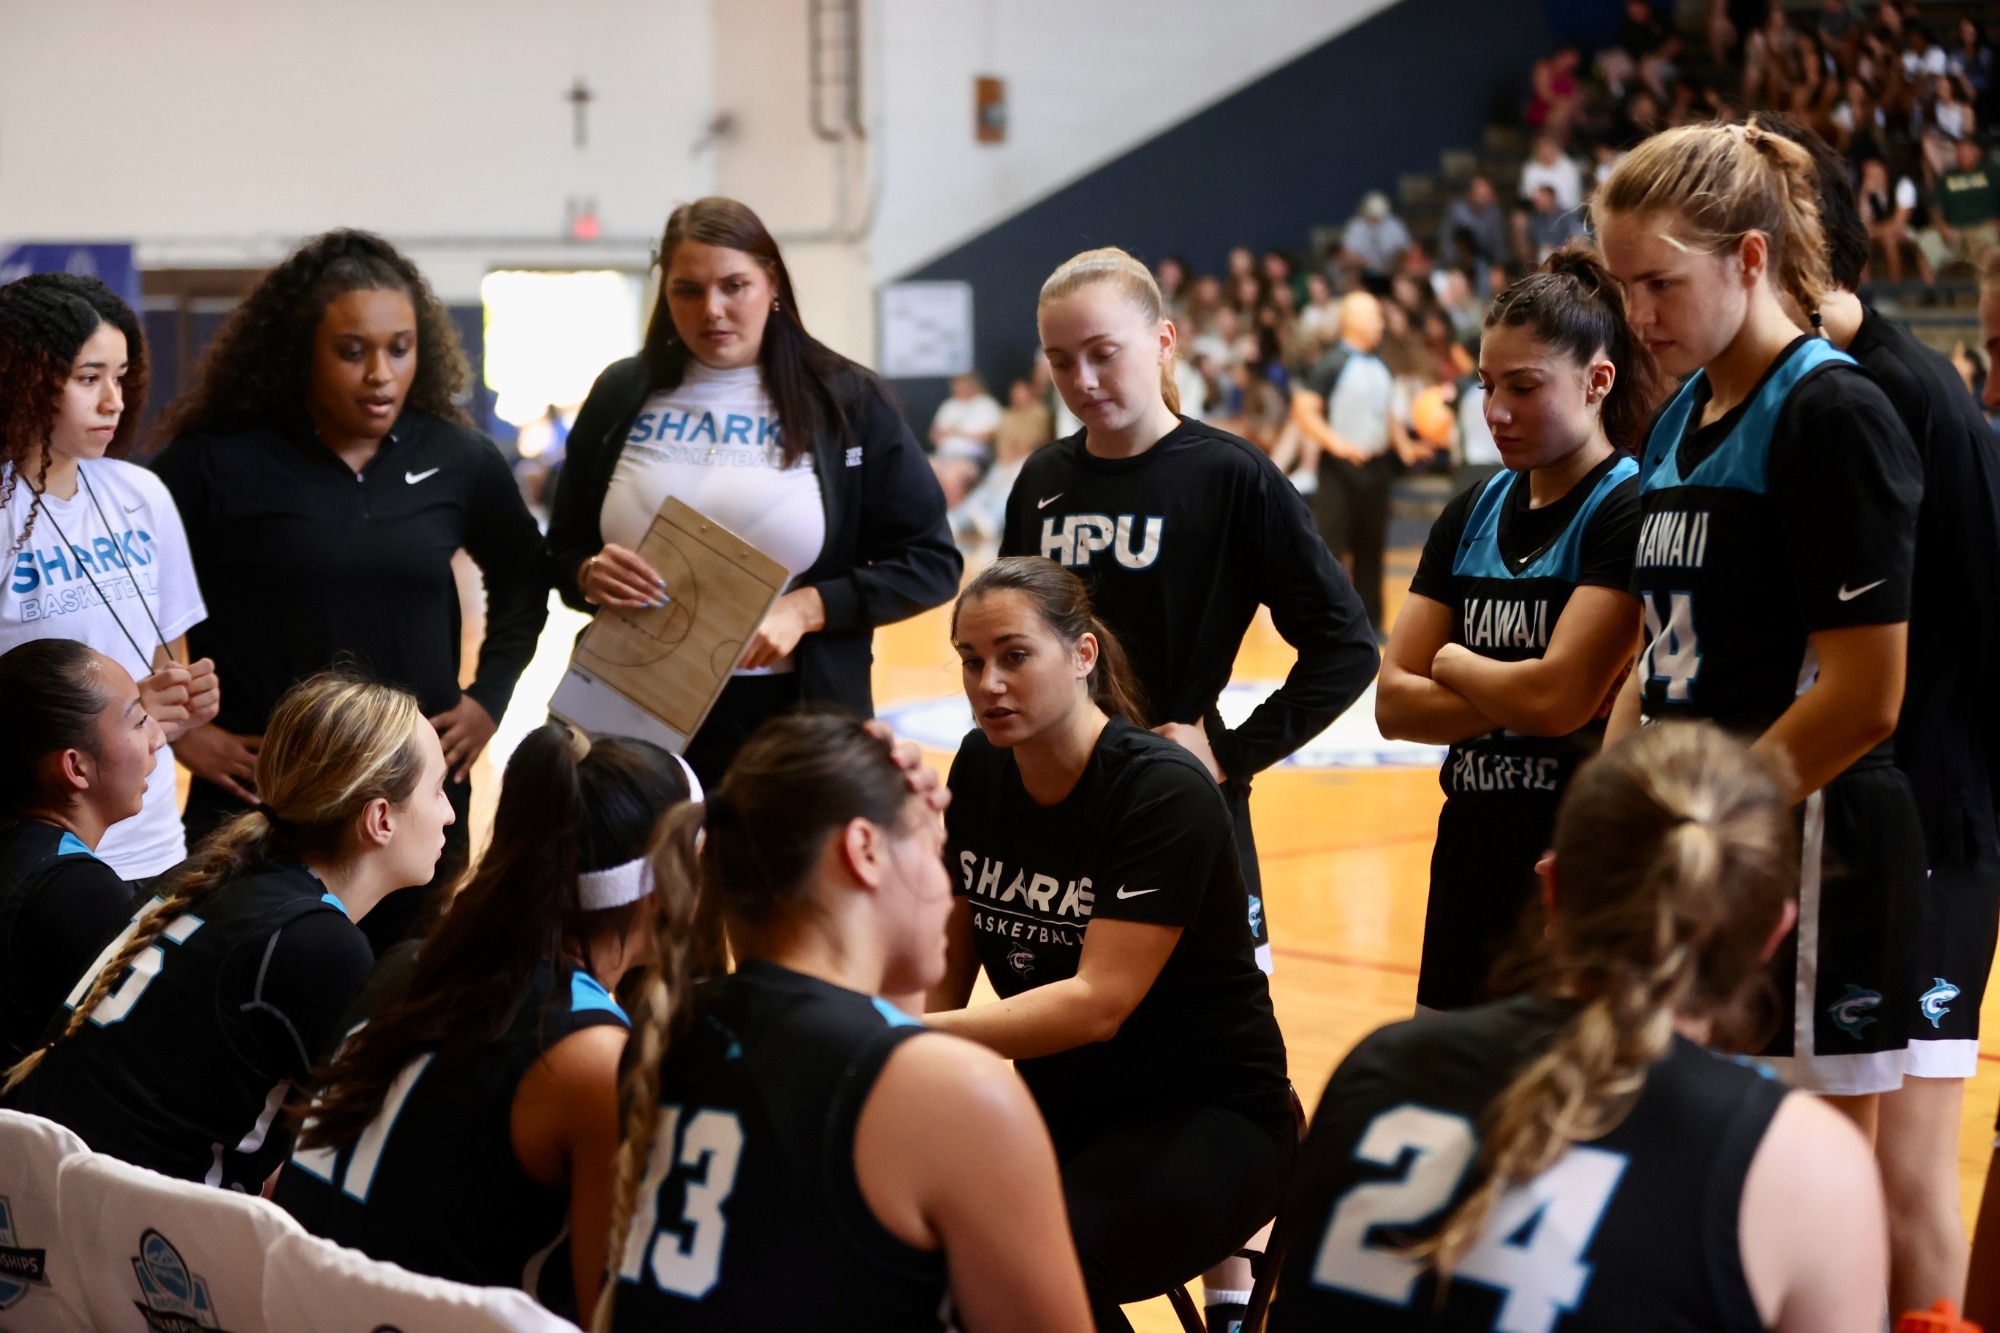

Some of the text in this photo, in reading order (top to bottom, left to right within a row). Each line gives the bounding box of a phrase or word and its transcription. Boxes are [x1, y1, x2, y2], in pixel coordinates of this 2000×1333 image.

[627, 411, 784, 448] SHARK
[1040, 513, 1165, 571] HPU
[1635, 511, 1710, 568] HAWAII
[1463, 598, 1548, 648] HAWAII
[1452, 748, 1559, 791] PACIFIC
[960, 850, 1096, 918] SHARKS
[973, 912, 1084, 946] ASKETBAL
[1308, 1102, 1633, 1333] 24
